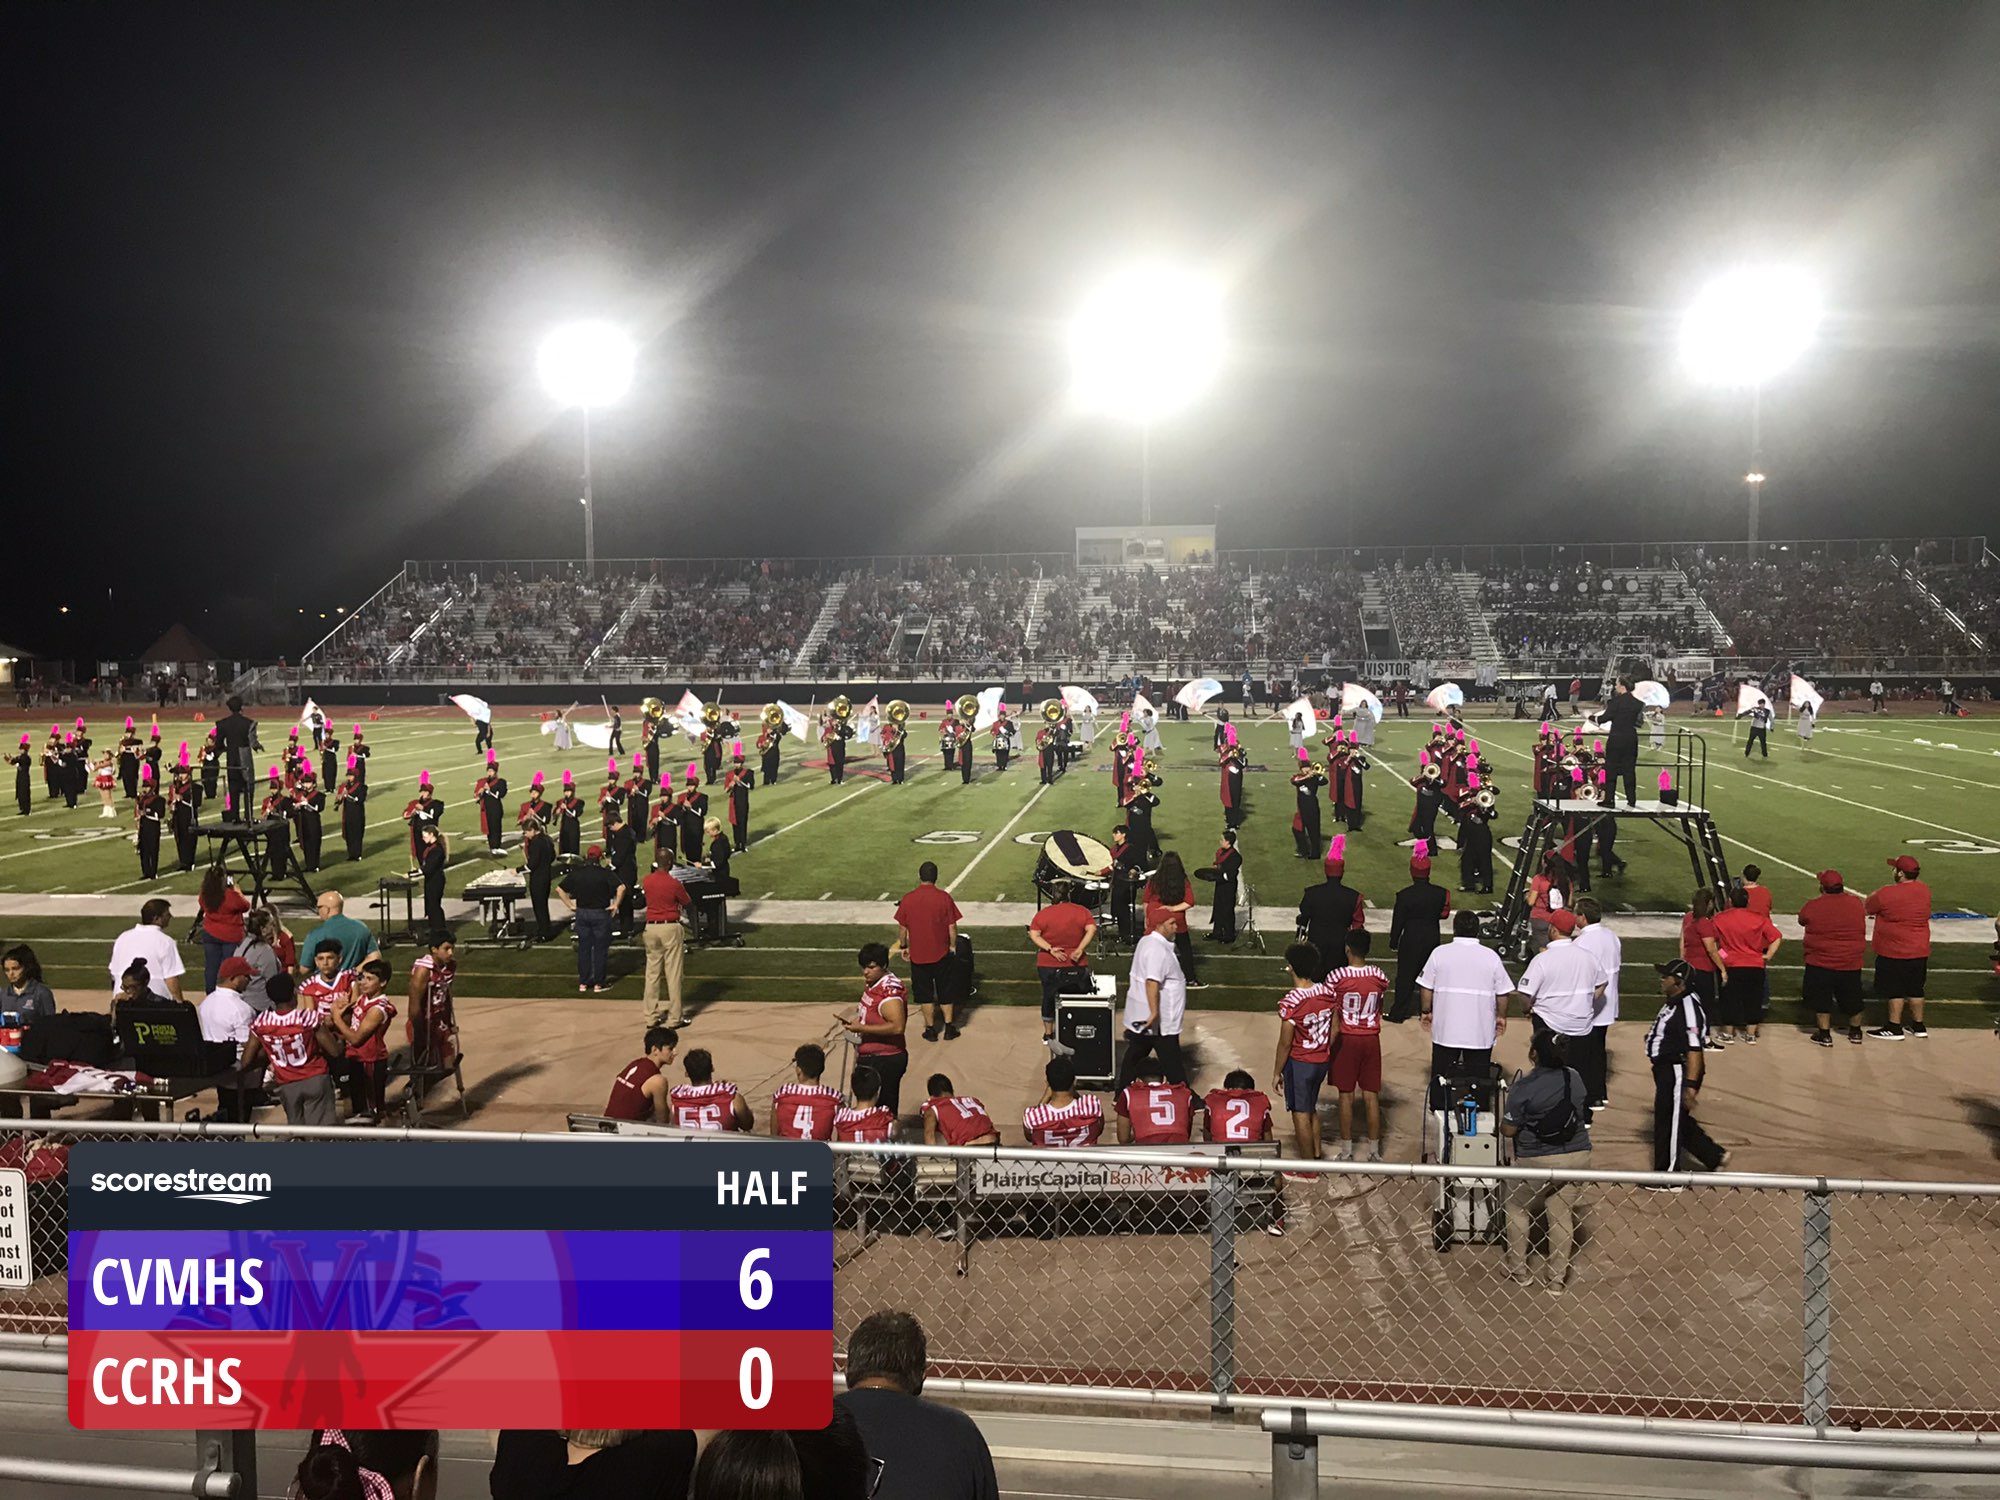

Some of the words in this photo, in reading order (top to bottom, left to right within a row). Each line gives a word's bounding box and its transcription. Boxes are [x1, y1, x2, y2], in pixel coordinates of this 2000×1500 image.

[1366, 662, 1410, 675] VISITOR
[912, 830, 983, 845] 5
[1342, 991, 1379, 1028] 84
[793, 1105, 814, 1141] 4
[1149, 1088, 1176, 1126] 5
[1225, 1098, 1251, 1140] 2
[982, 1170, 1108, 1188] PlainsCapital
[1110, 1170, 1153, 1186] Bank
